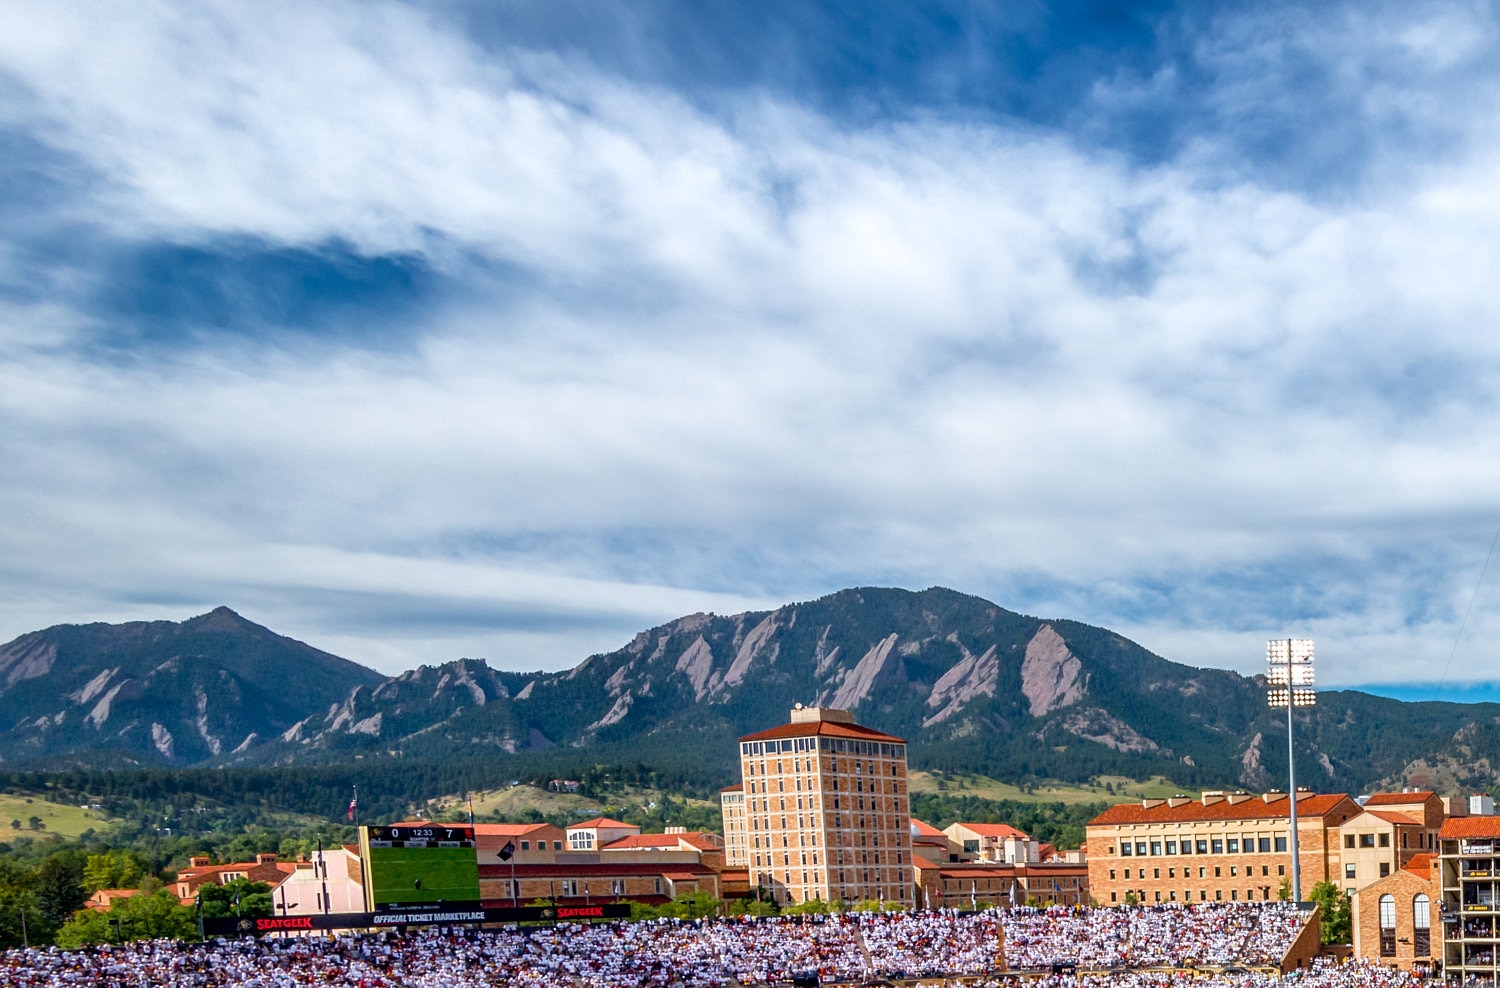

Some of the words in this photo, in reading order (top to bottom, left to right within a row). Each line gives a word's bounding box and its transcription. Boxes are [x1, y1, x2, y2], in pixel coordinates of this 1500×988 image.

[391, 828, 399, 838] 0
[412, 829, 433, 837] 12:33
[445, 829, 453, 838] 7
[557, 907, 604, 918] SEATGEEK
[374, 915, 407, 924] OFFICIAL
[408, 914, 433, 922] TICKET
[434, 912, 485, 922] MARKETPLACE
[256, 917, 313, 930] SEATGEEK
